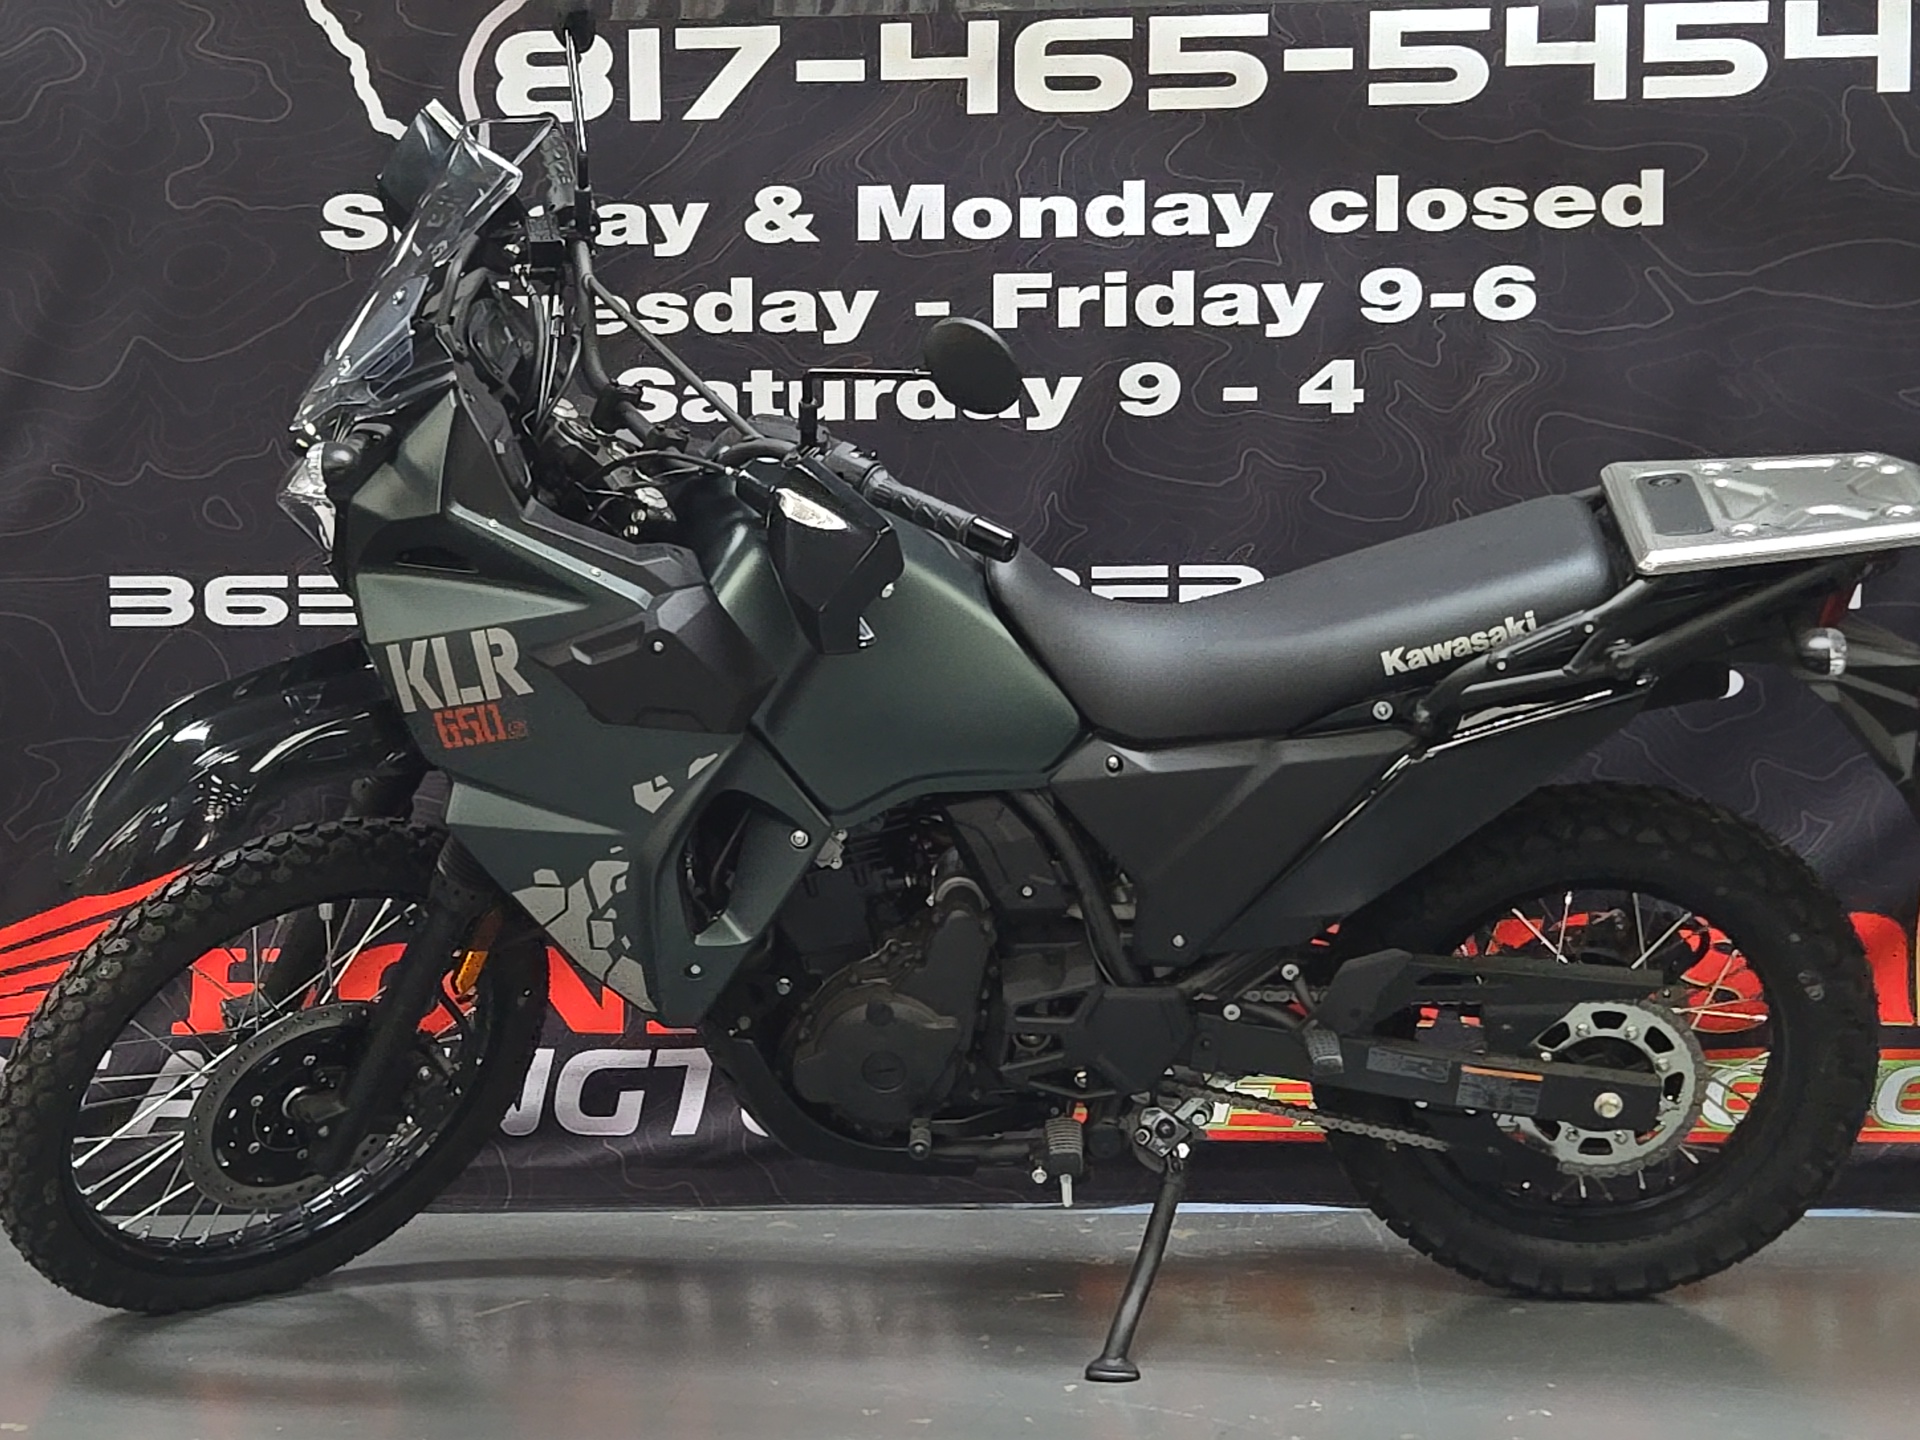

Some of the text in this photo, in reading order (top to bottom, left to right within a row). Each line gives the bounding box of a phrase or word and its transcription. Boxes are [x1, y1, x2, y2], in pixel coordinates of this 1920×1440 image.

[495, 0, 1912, 123] 817-465-5454
[744, 186, 820, 243] &
[857, 180, 1274, 248] Monday
[1308, 169, 1665, 232] closed
[497, 265, 1537, 345] esday - Friday 9-6
[616, 359, 1365, 431] Saturdy 9 - 4
[385, 627, 535, 713] KLR
[1380, 609, 1538, 676] Kawasaki
[433, 703, 507, 750] 650
